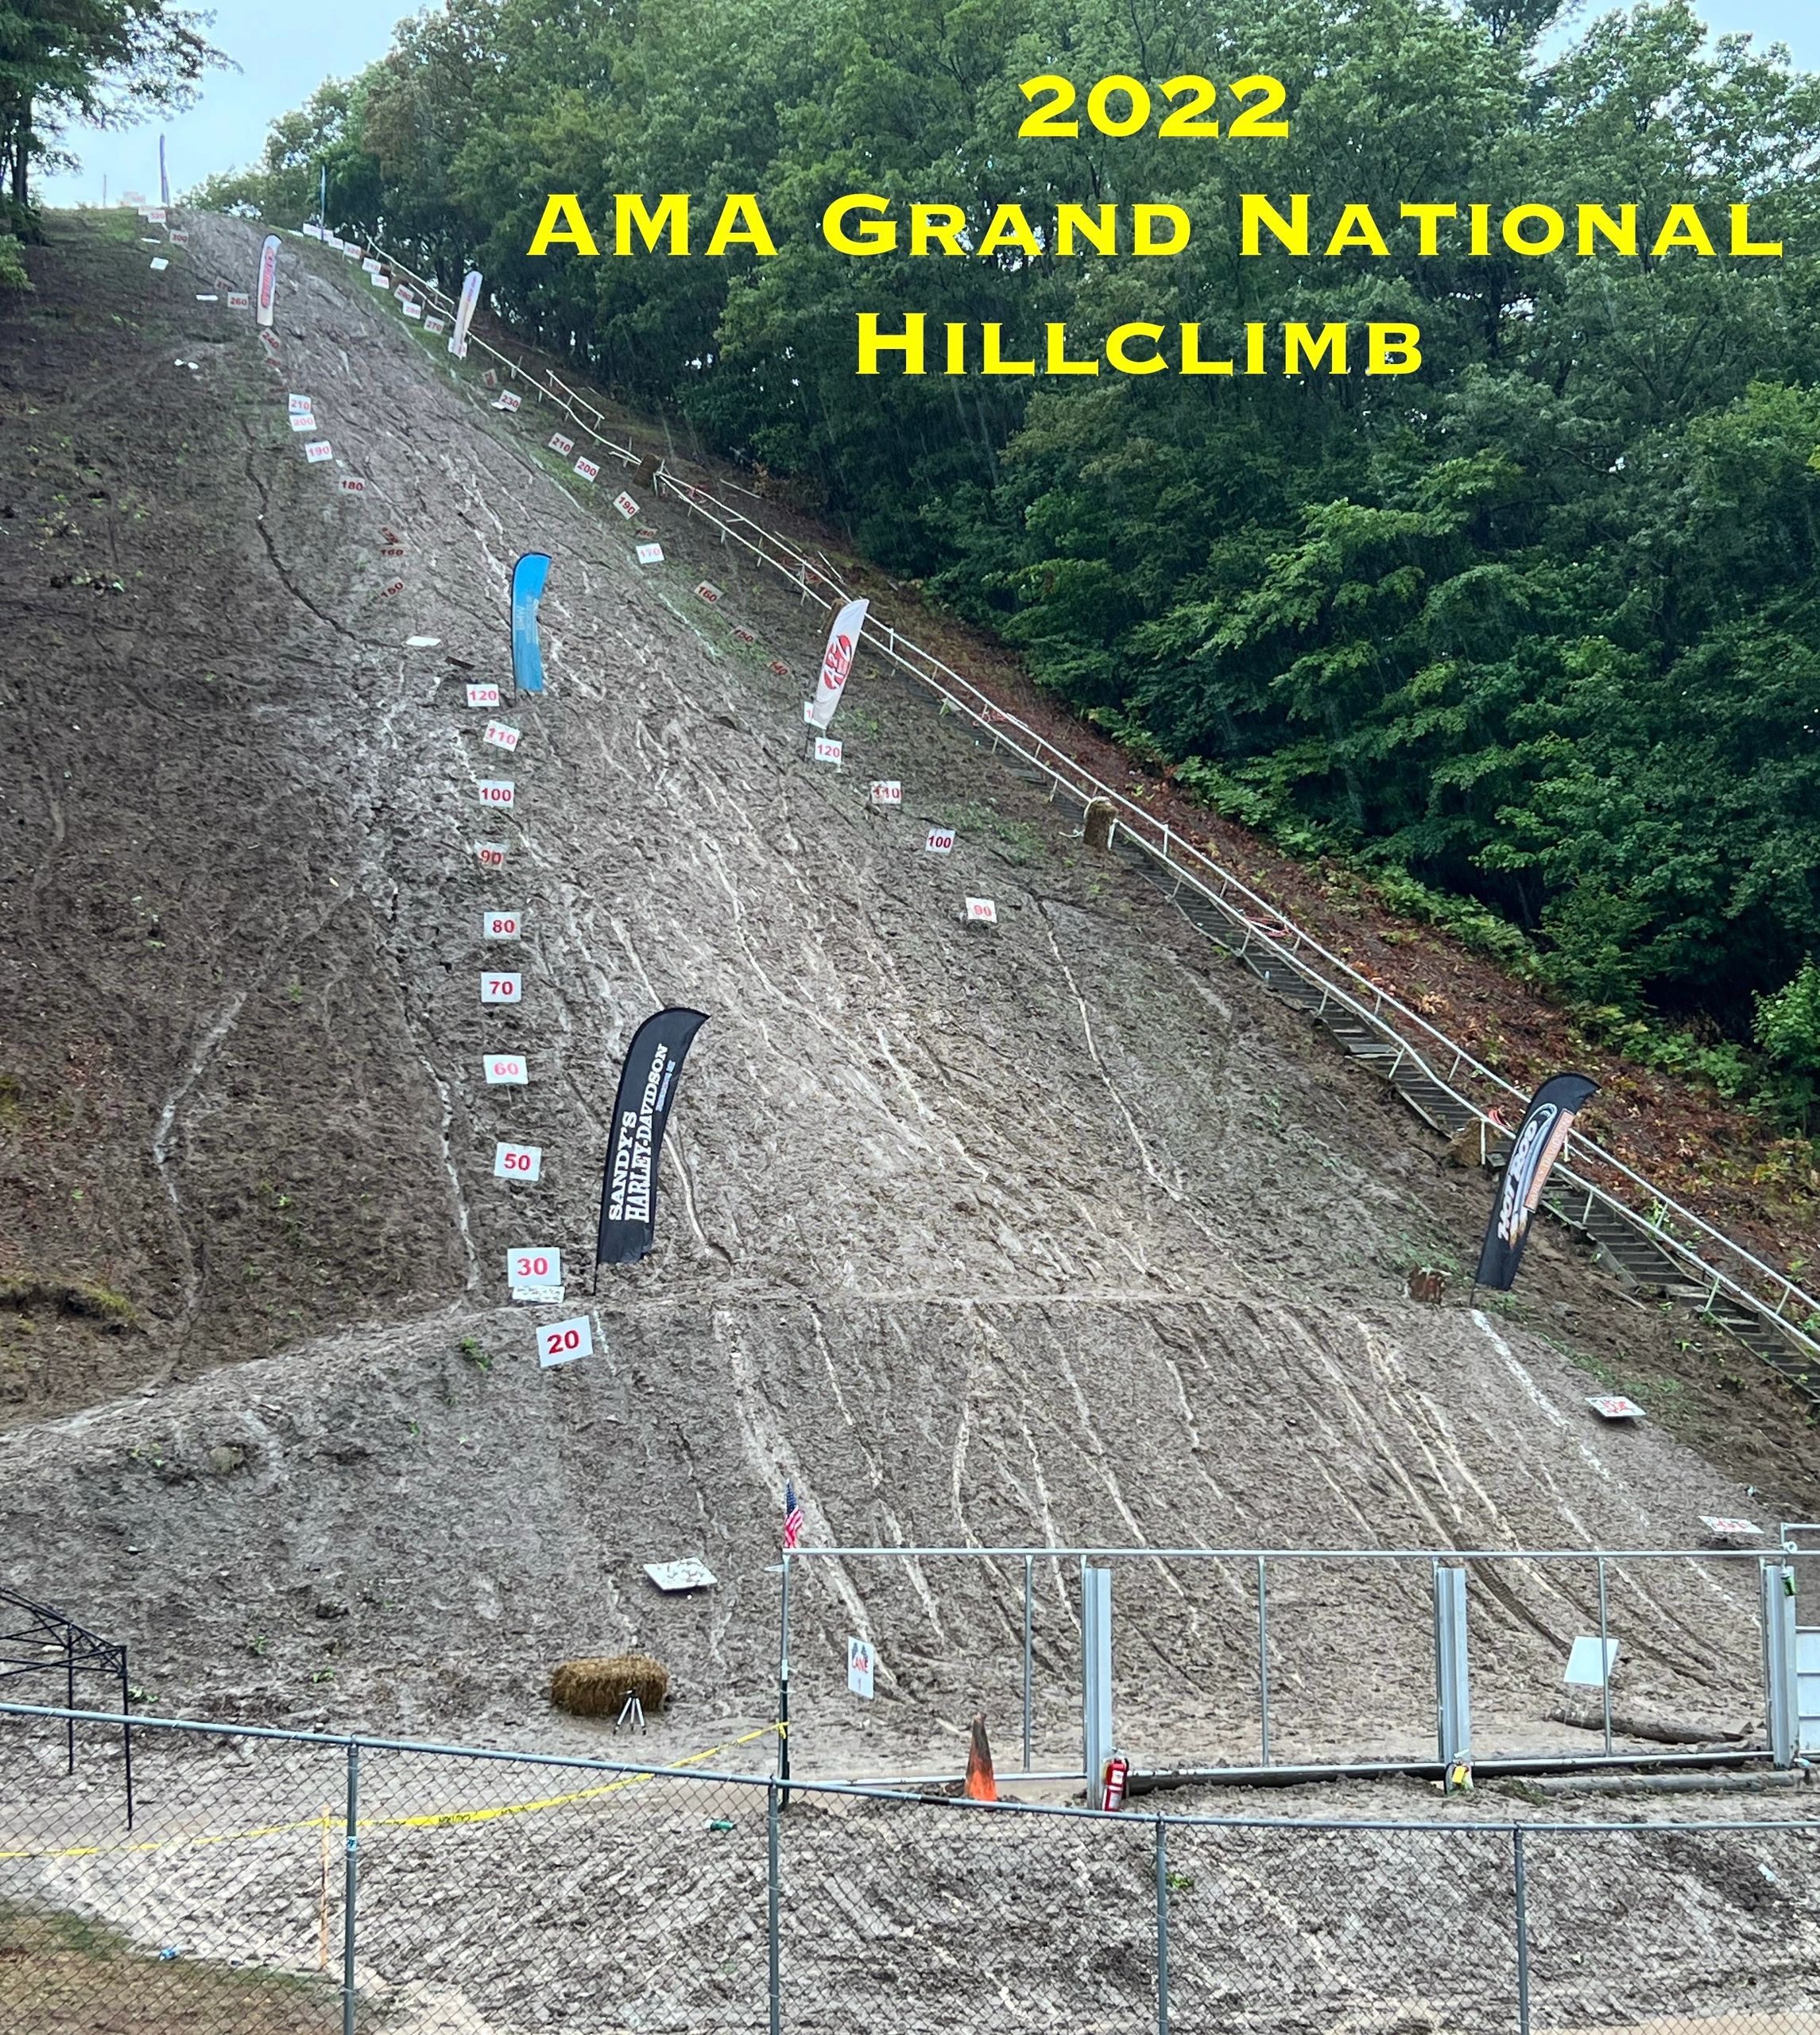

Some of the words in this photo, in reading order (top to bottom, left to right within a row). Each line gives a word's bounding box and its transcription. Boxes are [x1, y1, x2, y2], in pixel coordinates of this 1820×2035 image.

[426, 320, 442, 331] 270
[291, 399, 310, 410] 210
[501, 394, 519, 408] 230
[293, 417, 313, 426] 200
[309, 446, 330, 456] 190
[552, 437, 571, 452] 210
[577, 460, 597, 476] 200
[342, 480, 363, 491] 180
[618, 496, 636, 515] 190
[698, 586, 718, 603] 160
[769, 661, 788, 676] 140
[470, 690, 497, 701] 120
[488, 727, 517, 745] 110
[817, 744, 840, 758] 120
[482, 788, 513, 802] 100
[928, 835, 952, 849] 100
[480, 849, 502, 865] 90
[493, 920, 516, 933] 80
[490, 980, 513, 995] 70
[494, 1062, 519, 1076] 60
[625, 1043, 668, 1223] HARLEY-DAVIDSON
[503, 1153, 531, 1171] 50
[609, 1111, 637, 1221] SANDY'S
[1497, 1176, 1516, 1239] HOT
[1508, 1120, 1538, 1180] ROD
[517, 1258, 548, 1276] 30
[547, 1330, 579, 1355] 20
